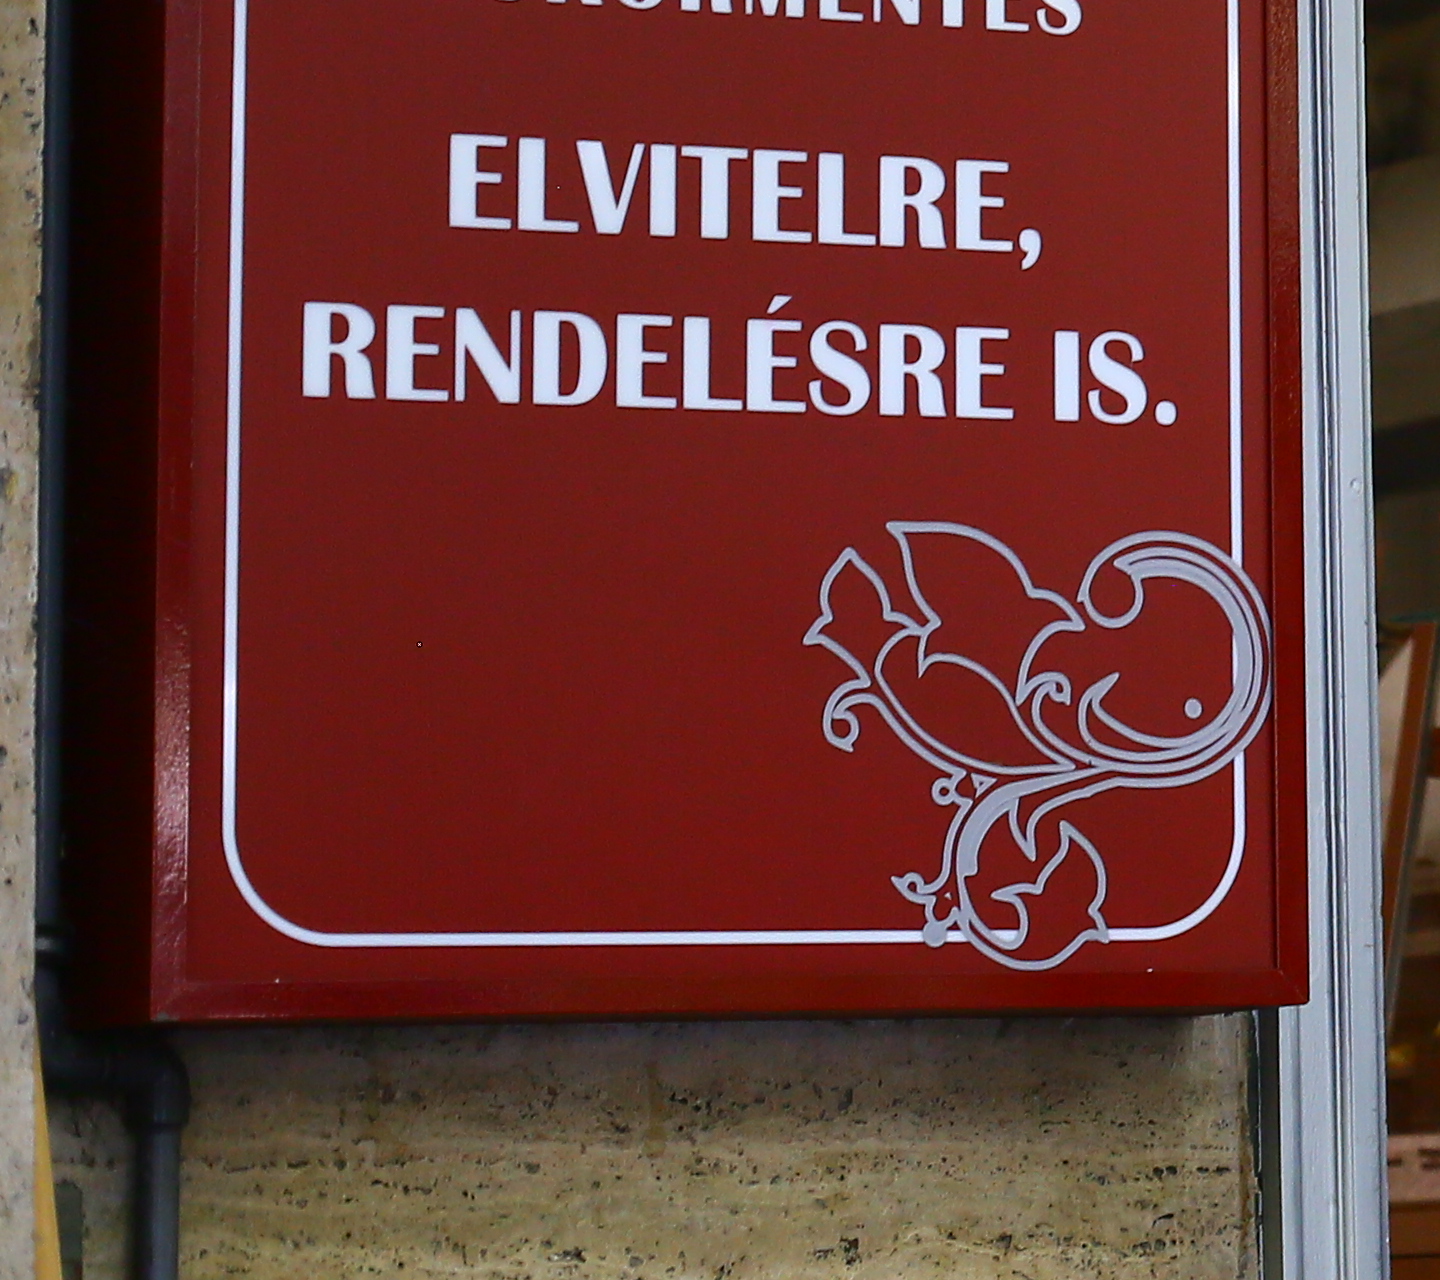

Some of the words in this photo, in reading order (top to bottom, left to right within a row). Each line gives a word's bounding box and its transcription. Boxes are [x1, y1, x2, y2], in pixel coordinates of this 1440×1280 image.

[449, 133, 1043, 270] ELVITELRE,
[302, 295, 1015, 420] RENDELÉSRE
[1054, 330, 1178, 427] IS.
